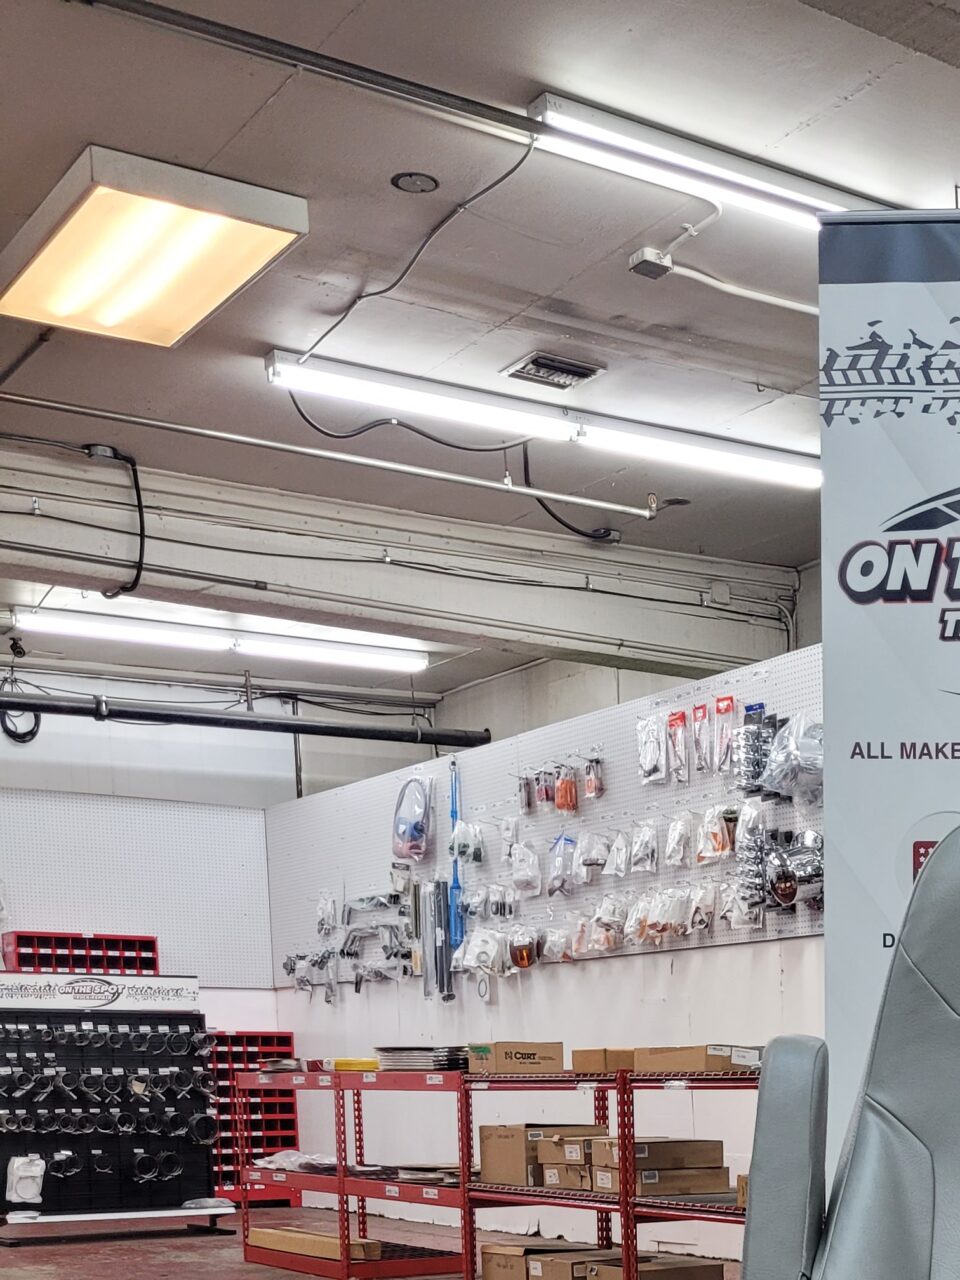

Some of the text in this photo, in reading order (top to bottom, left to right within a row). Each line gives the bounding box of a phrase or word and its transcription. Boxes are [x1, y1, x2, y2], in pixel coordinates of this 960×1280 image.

[838, 539, 945, 603] ON
[850, 741, 893, 760] ALL
[58, 983, 126, 994] ON THE SPOT
[514, 1051, 537, 1060] CURT
